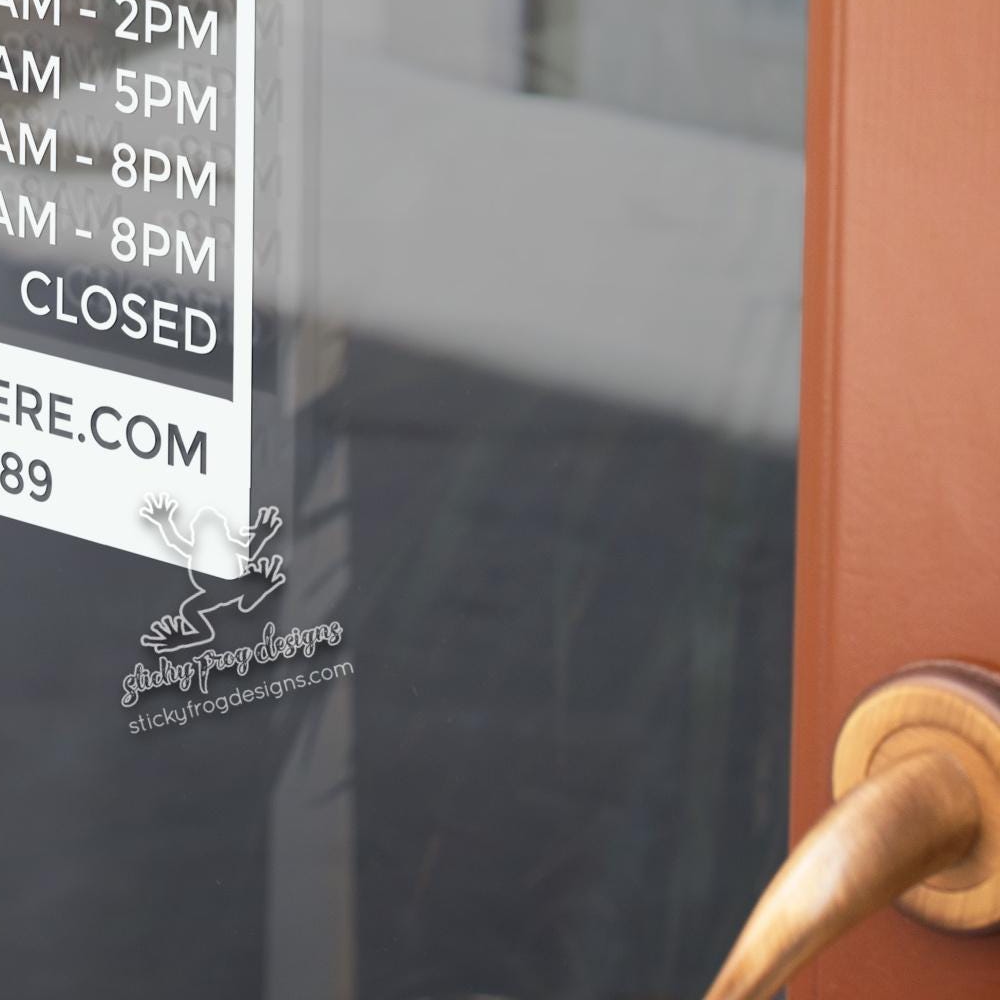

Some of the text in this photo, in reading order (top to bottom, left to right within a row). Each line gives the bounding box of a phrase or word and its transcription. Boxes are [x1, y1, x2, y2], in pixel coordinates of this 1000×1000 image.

[79, 8, 96, 18] -
[79, 82, 96, 92] -
[114, 68, 217, 132] 5PM
[76, 155, 93, 165] -
[111, 142, 217, 207] 8PM
[75, 228, 92, 239] -
[110, 216, 216, 282] 8PM
[20, 270, 217, 354] CLOSED
